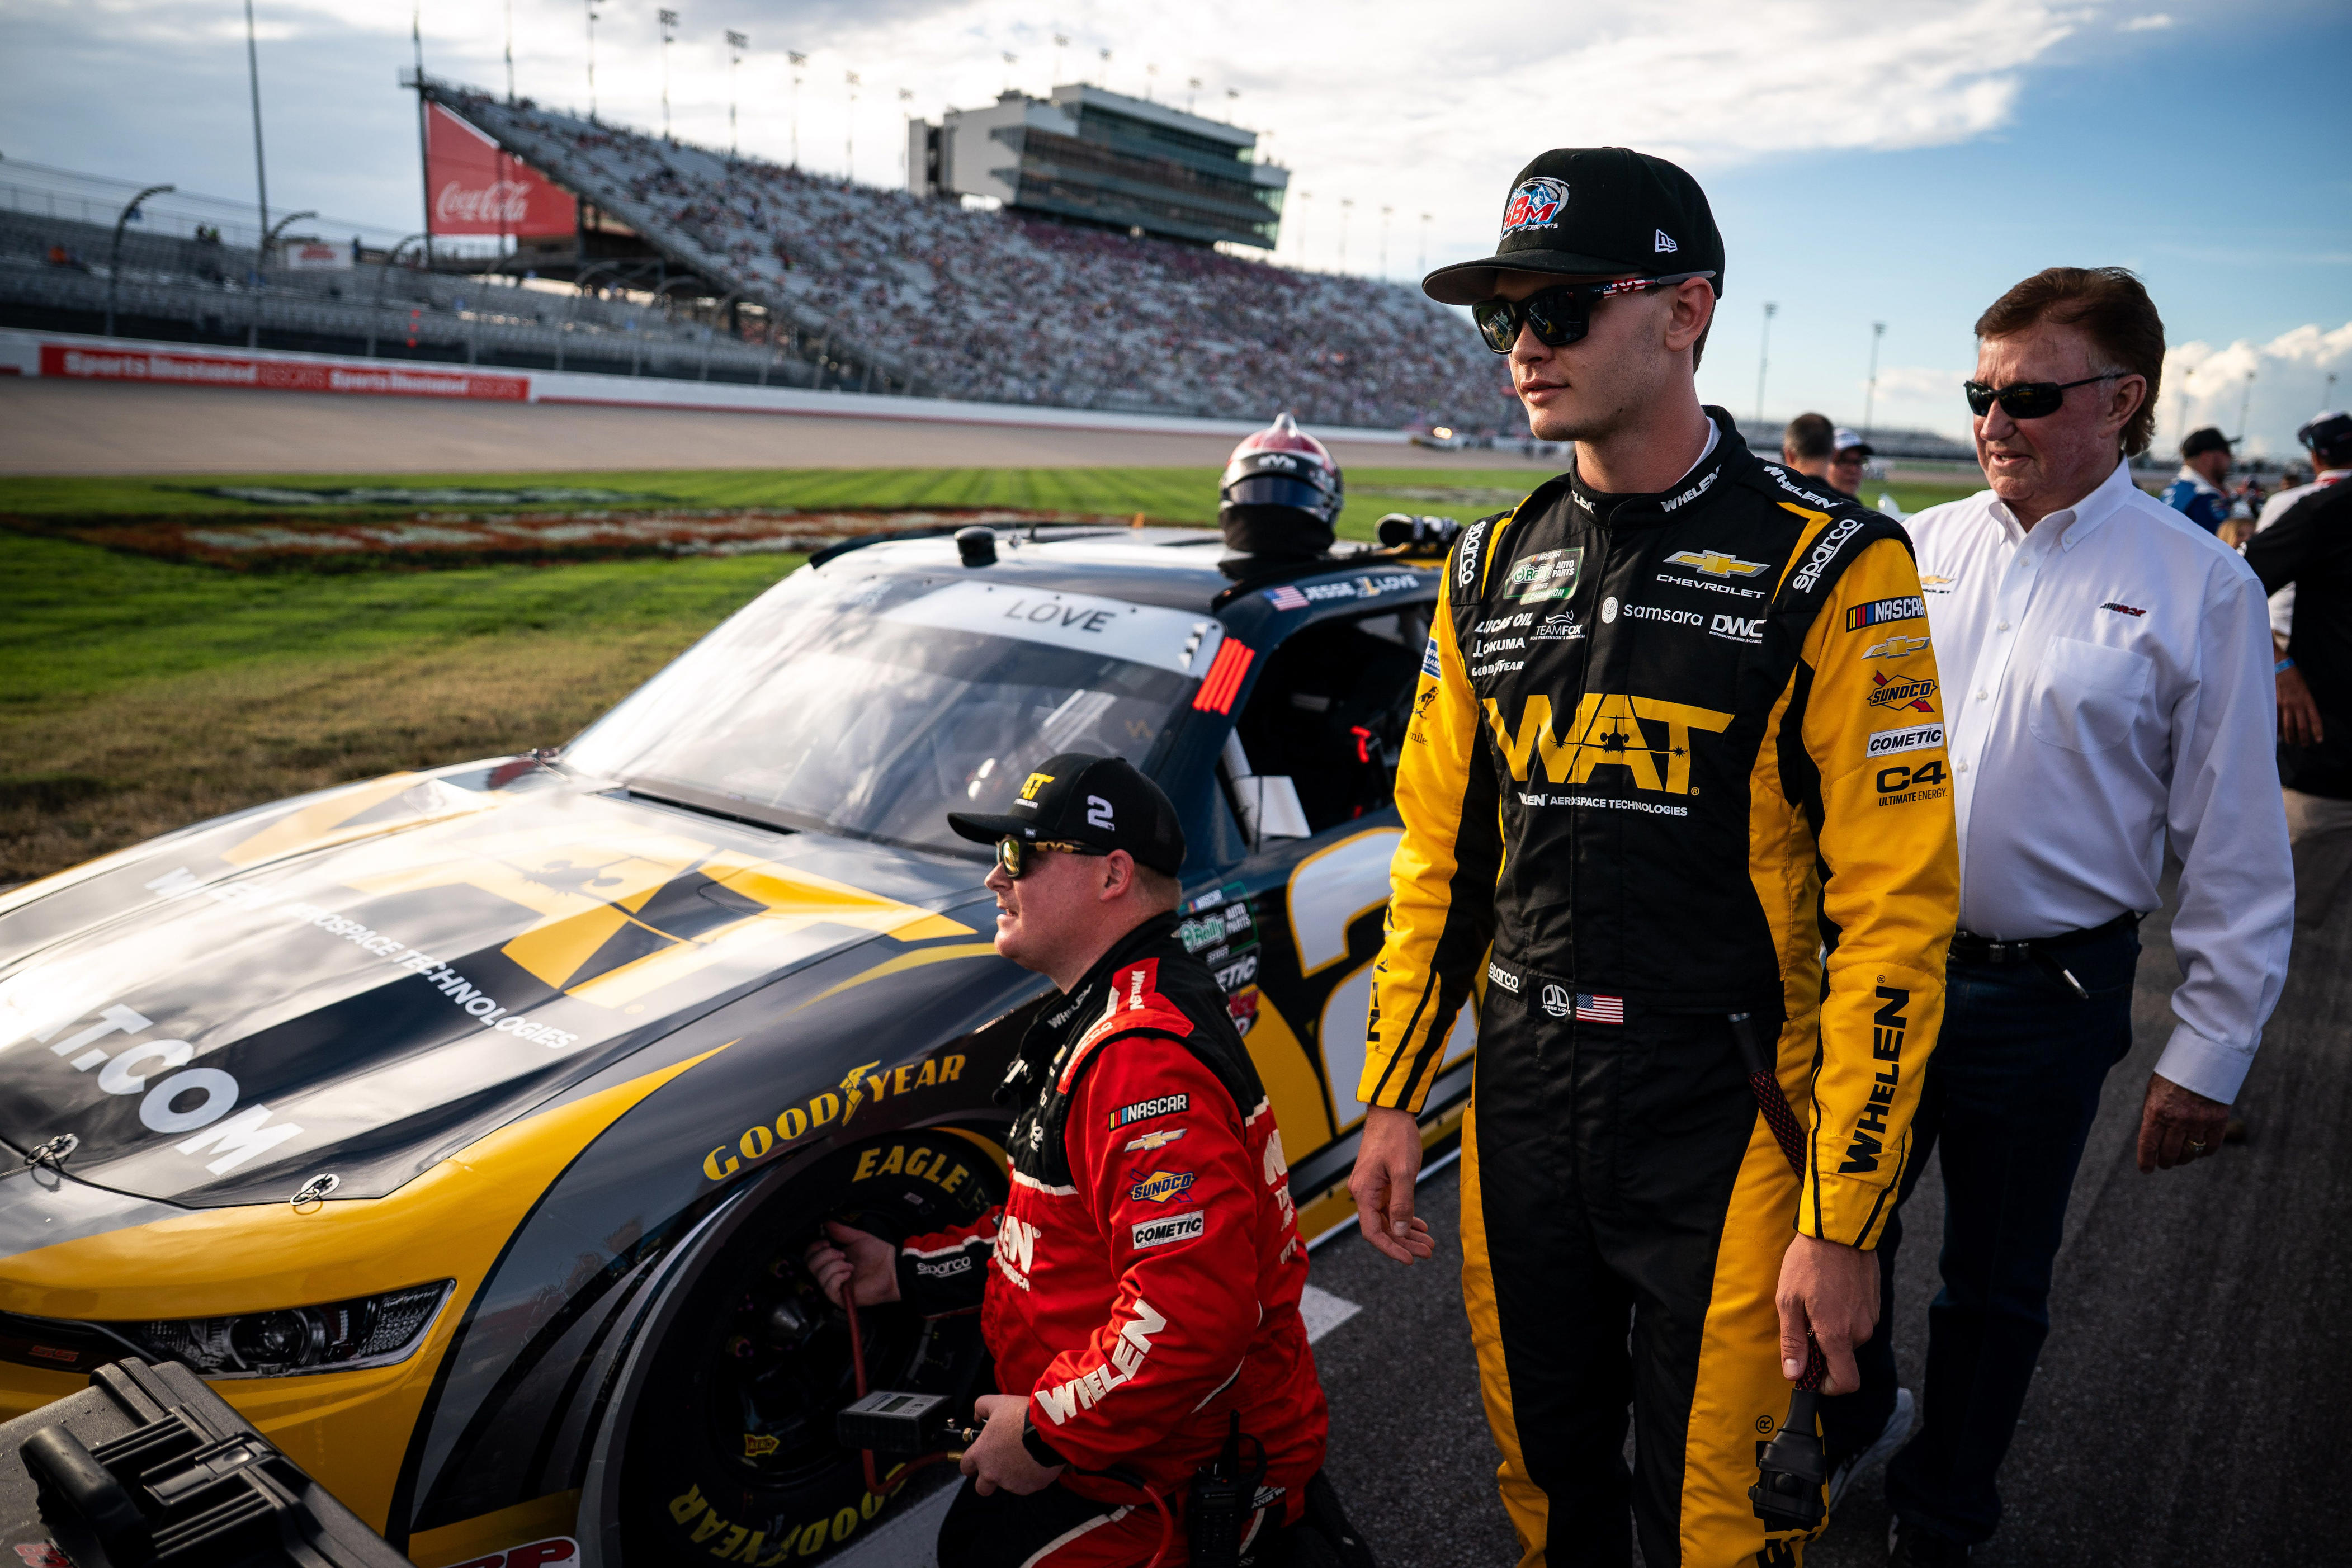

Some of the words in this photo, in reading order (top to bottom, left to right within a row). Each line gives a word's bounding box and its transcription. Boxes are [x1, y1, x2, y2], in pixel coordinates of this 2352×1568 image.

[1763, 466, 1840, 508] WHELEN
[1459, 521, 1486, 588] sparco
[1538, 550, 1562, 561] NASCAR
[1556, 560, 1575, 570] AUTO
[1792, 519, 1865, 594] sparco
[1513, 564, 1555, 583] O'Reilly
[1552, 568, 1575, 578] PARTS
[1303, 582, 1356, 601] JESSE
[1378, 574, 1420, 593] LOVE
[1529, 588, 1565, 601] CHAMPION
[1531, 583, 1548, 591] SERIES
[1656, 574, 1765, 598] CHEVROLET
[1004, 601, 1116, 632] LOVE
[1623, 603, 1704, 626] samsara
[1873, 597, 1925, 623] NASCAR
[1474, 615, 1513, 634] LUCAS
[1513, 612, 1533, 627] OIL
[1709, 630, 1736, 641] DISTRIBUTOR
[1710, 614, 1767, 637] DWC
[1472, 659, 1524, 677] GOODYEAR
[1872, 680, 1931, 705] SUNOCO
[1482, 693, 1735, 795] WAT
[1870, 729, 1942, 752] COMETIC
[1019, 772, 1056, 800] AT
[1876, 760, 1947, 794] C4
[1550, 796, 1607, 809] AEROSPACE
[1608, 799, 1688, 817] TECHNOLOGIES
[1879, 792, 1917, 807] ULTIMATE
[1087, 795, 1116, 832] 2
[1216, 955, 1257, 991] ETIC
[1488, 961, 1519, 993] sparco
[391, 948, 579, 1050] TECHNOLOGIES
[1837, 985, 1910, 1174] WHELEN
[702, 1054, 966, 1182] GOODYEAR
[1127, 1094, 1187, 1122] NASCAR
[851, 1145, 970, 1194] EAGLE
[1134, 1175, 1192, 1198] SUNOCO
[1135, 1217, 1202, 1244] COMETIC
[1139, 1238, 1166, 1248] GASKET
[917, 1256, 972, 1278] sparco
[1035, 1298, 1168, 1426] WHELEN
